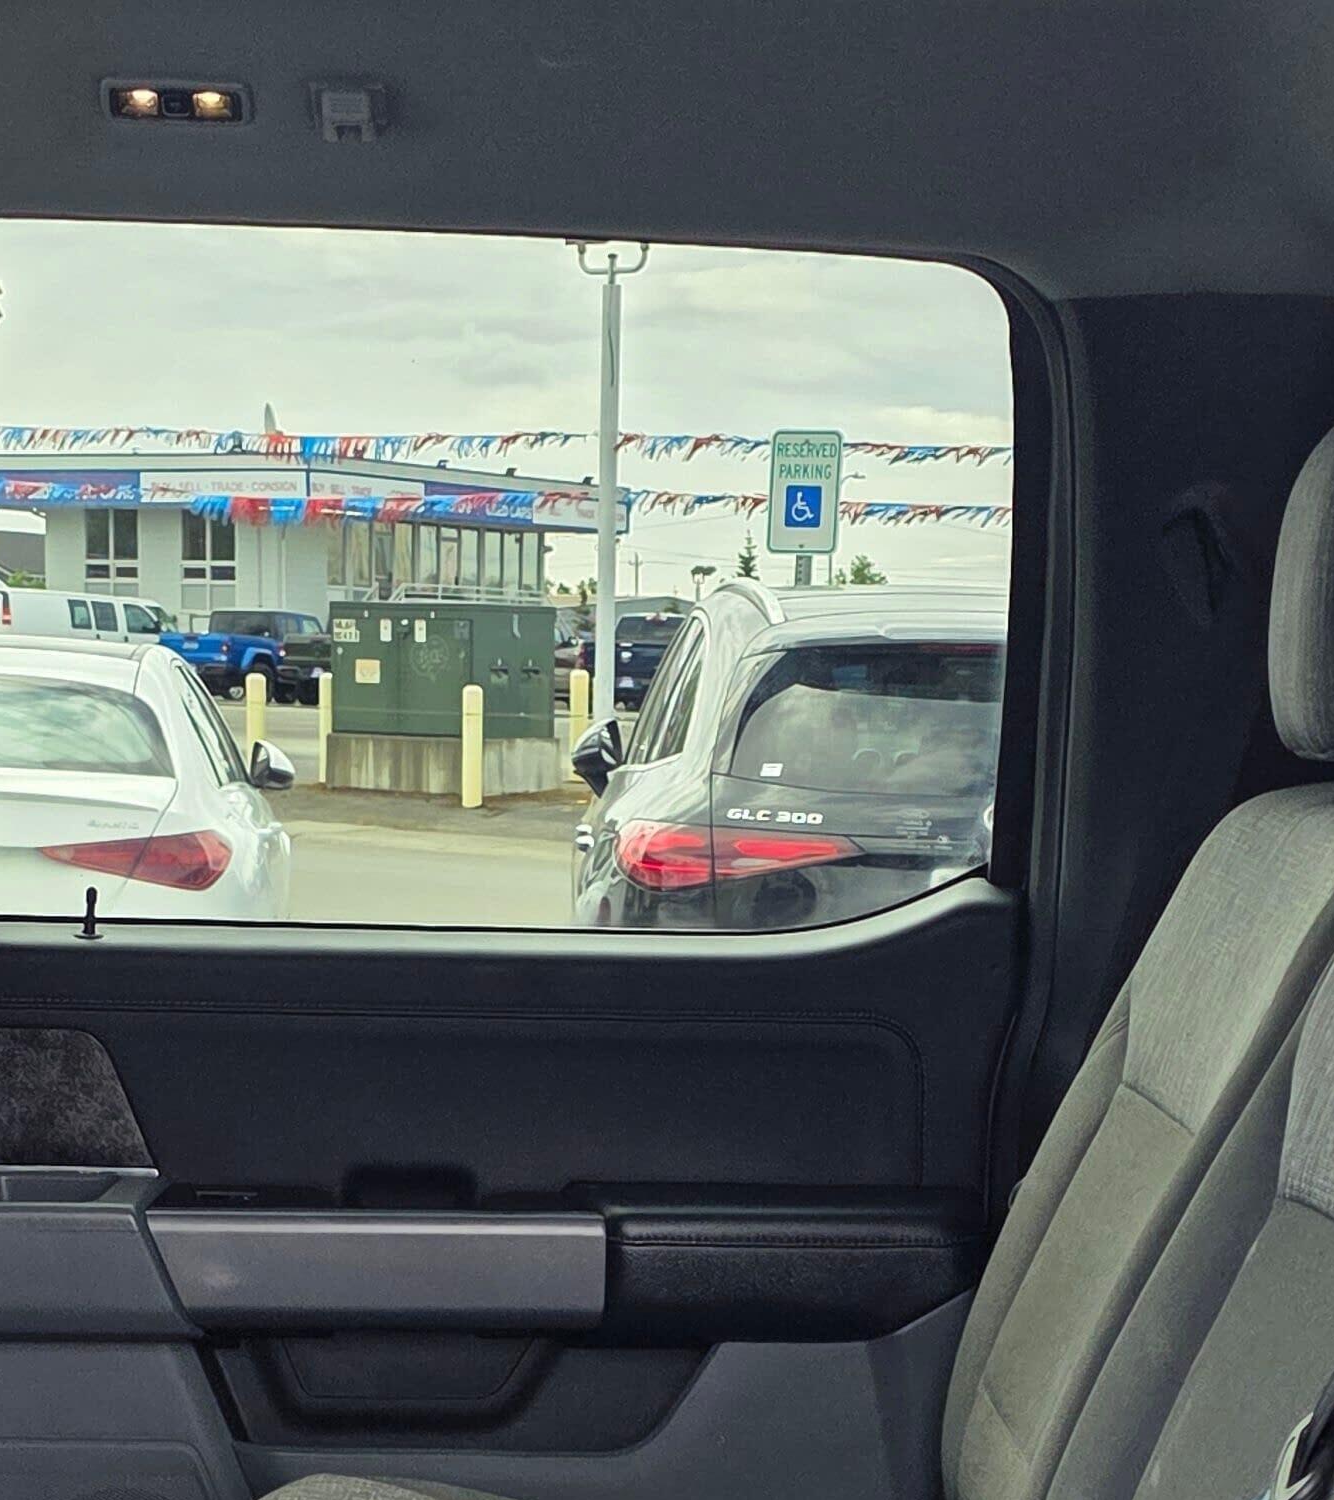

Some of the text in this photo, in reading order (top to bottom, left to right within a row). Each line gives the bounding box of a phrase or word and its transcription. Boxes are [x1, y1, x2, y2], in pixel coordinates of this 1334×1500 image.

[777, 442, 837, 457] RESERVED
[779, 463, 832, 479] PARKING
[251, 482, 297, 491] CONSIGN
[727, 808, 823, 824] GLC 300
